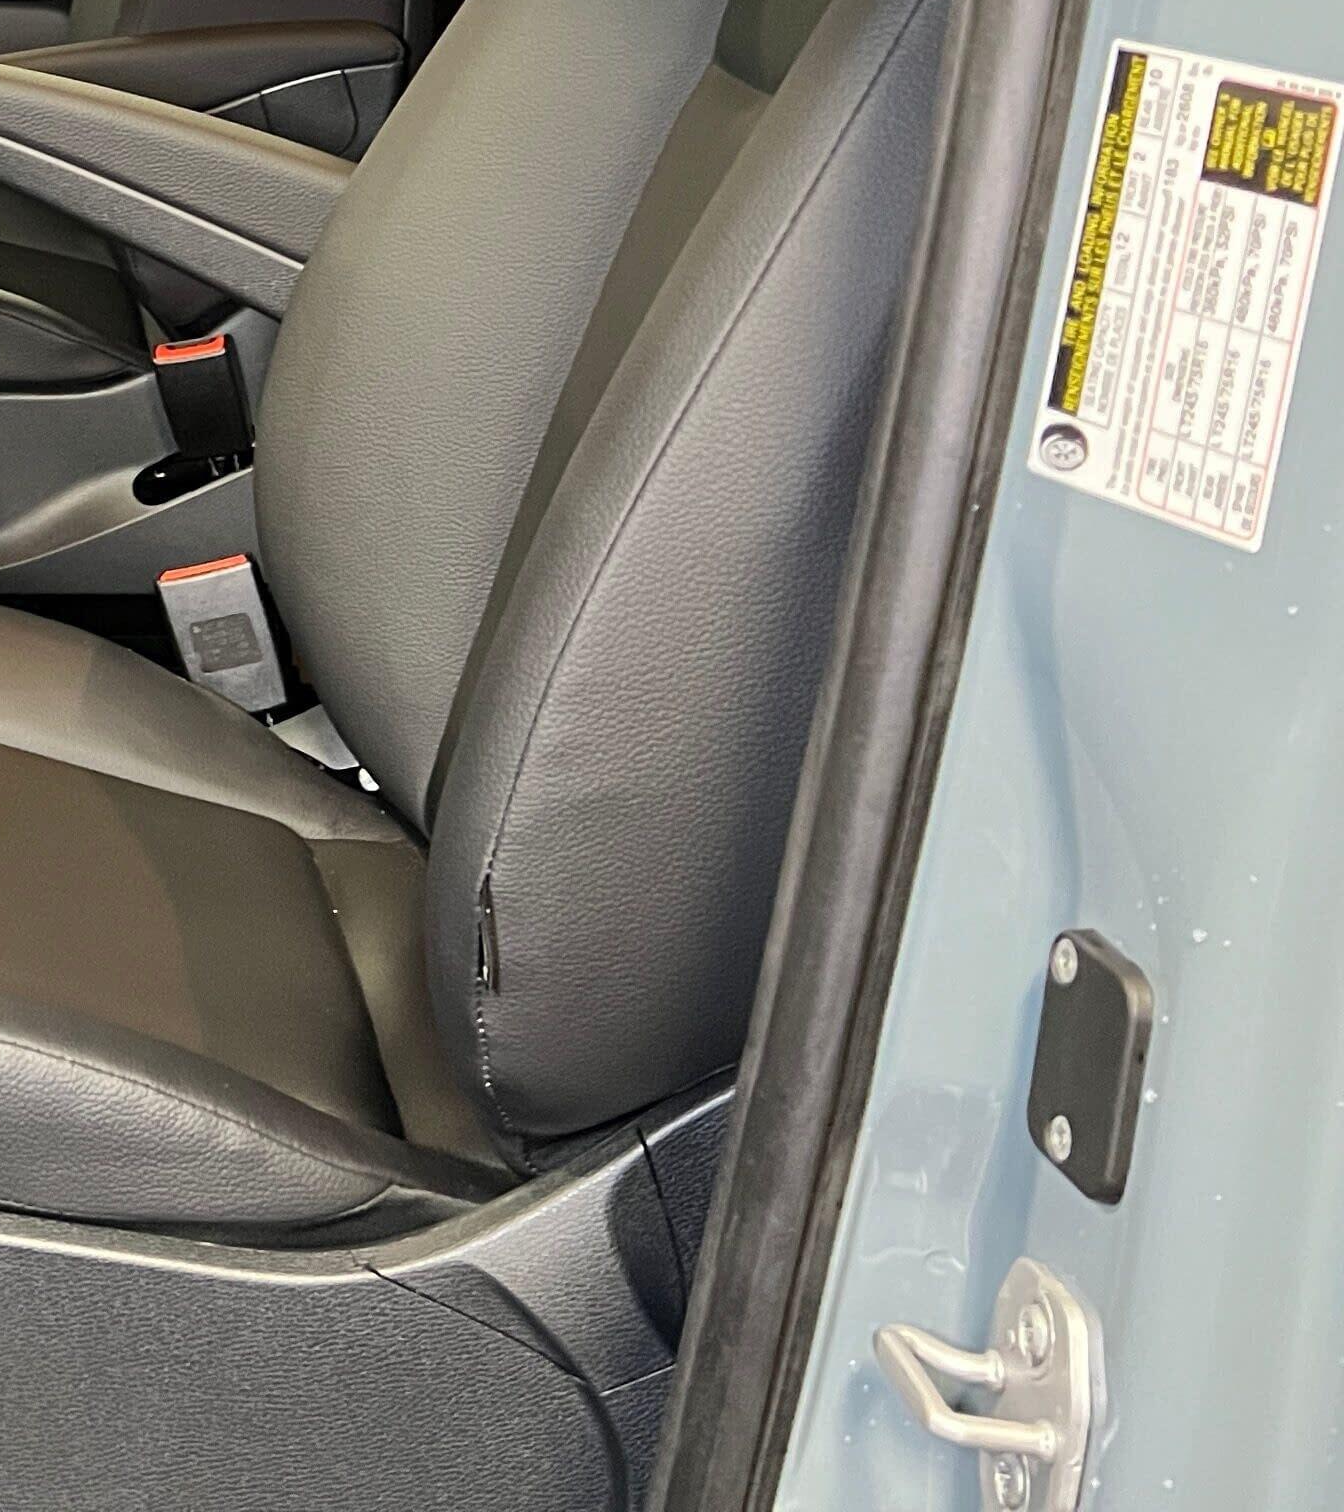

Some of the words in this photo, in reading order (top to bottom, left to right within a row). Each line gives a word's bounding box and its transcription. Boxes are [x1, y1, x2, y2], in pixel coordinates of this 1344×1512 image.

[1146, 67, 1163, 88] 10
[1114, 54, 1147, 147] CHARGEMENT
[1175, 81, 1195, 122] 2608
[1088, 112, 1119, 205] INFORMATION
[1075, 211, 1099, 273] LOADING
[1114, 230, 1130, 251] 12
[1068, 278, 1087, 311] AND
